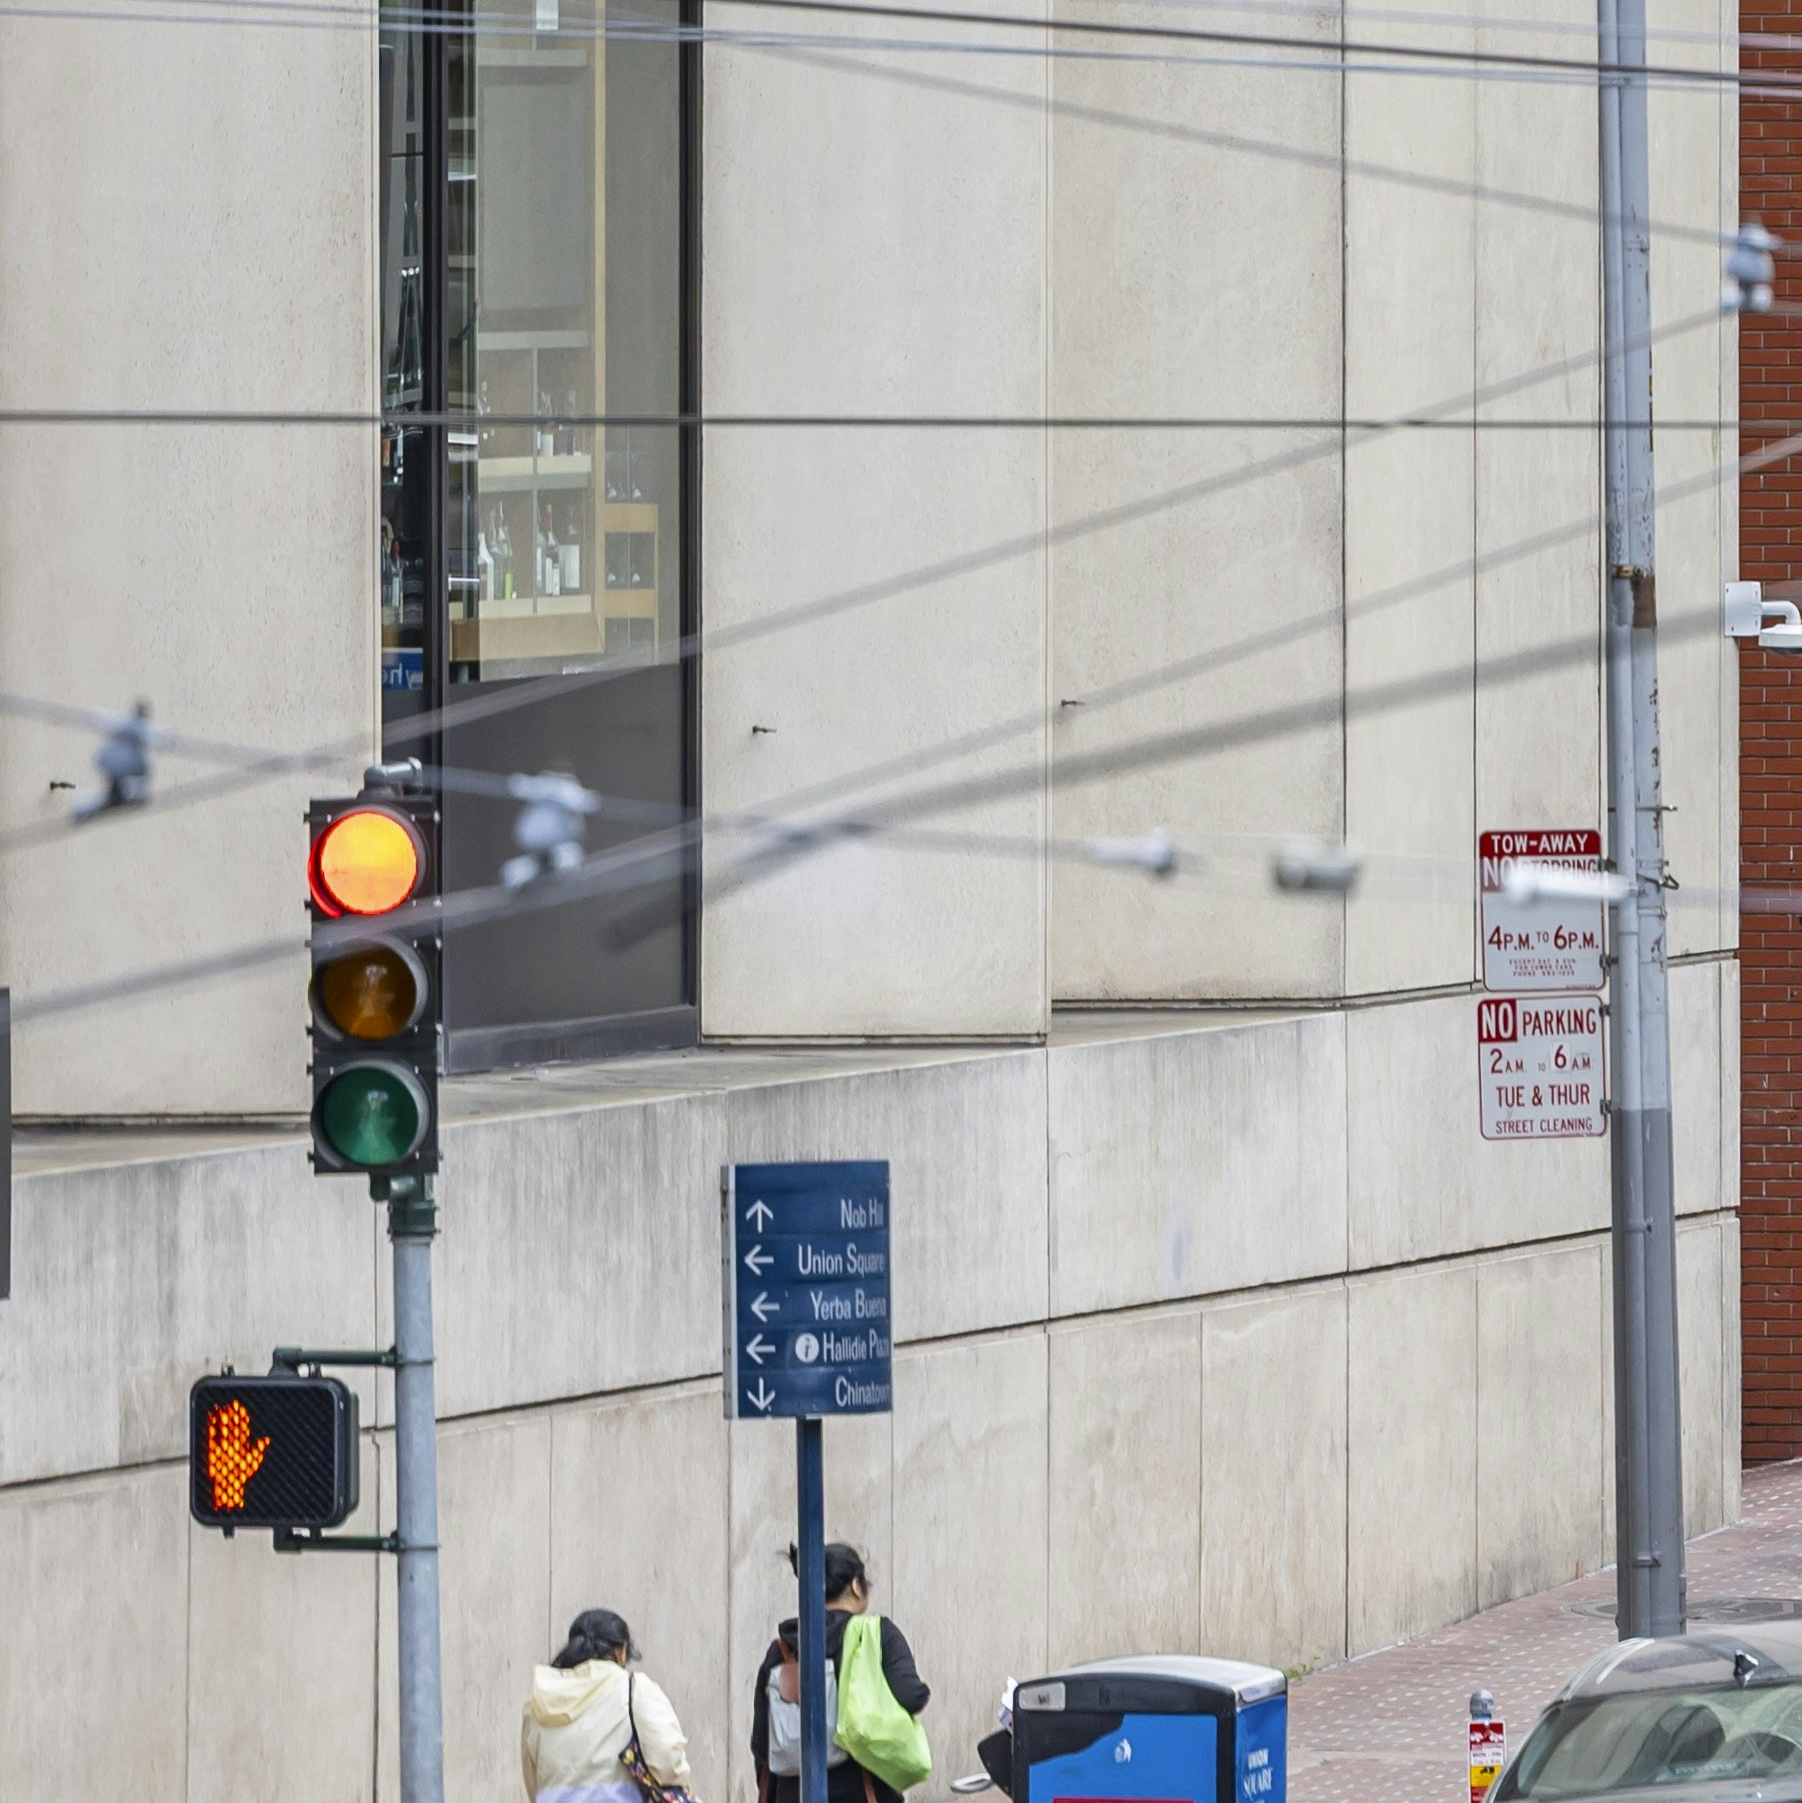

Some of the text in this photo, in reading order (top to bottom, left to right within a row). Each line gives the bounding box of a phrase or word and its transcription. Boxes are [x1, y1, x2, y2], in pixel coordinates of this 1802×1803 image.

[1491, 833, 1588, 854] TOW-AWAY
[1536, 931, 1549, 943] TO
[1482, 1001, 1597, 1040] NO PARKING
[1496, 1083, 1591, 1109] TUE & THUR
[1496, 1117, 1593, 1135] STREET CLEANING
[840, 1198, 884, 1229] Nob Hill
[798, 1242, 886, 1278] Union Square
[810, 1288, 887, 1321] Yerba Buena
[823, 1333, 867, 1364] Hallidie
[835, 1375, 891, 1408] Chinatown
